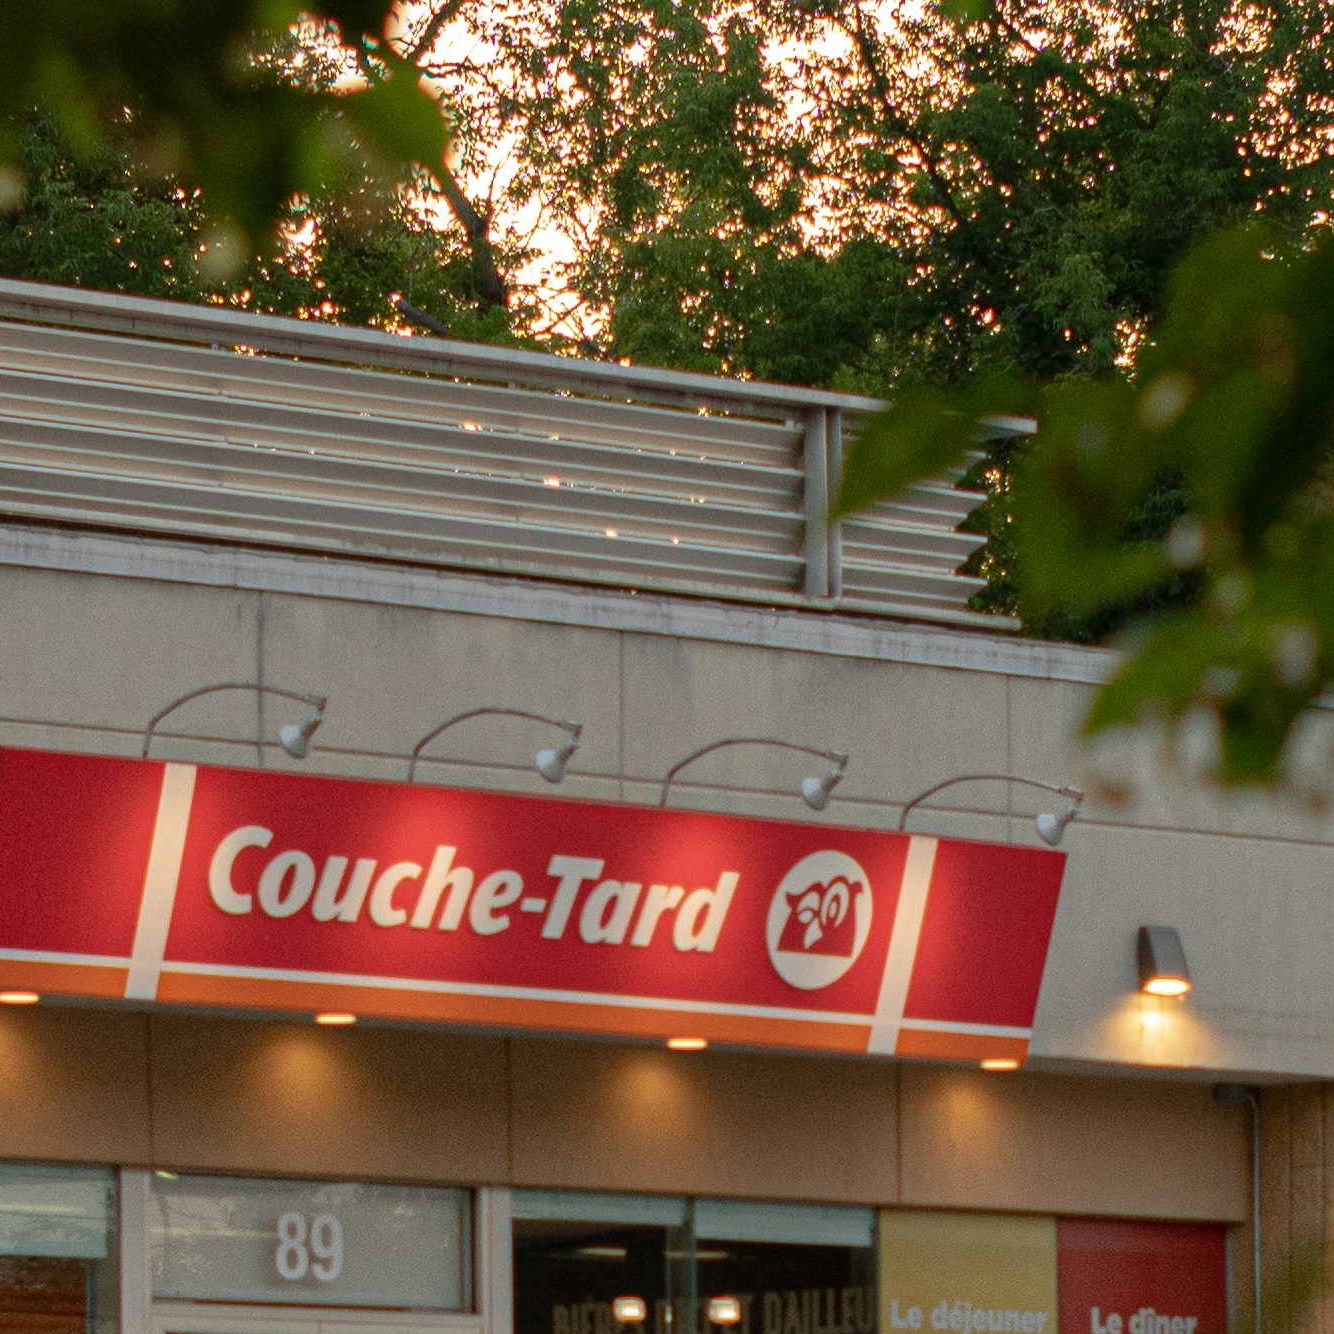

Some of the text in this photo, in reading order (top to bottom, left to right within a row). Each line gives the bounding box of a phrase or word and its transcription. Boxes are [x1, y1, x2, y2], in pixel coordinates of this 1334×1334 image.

[208, 824, 740, 953] Couche-Tard
[275, 1211, 345, 1281] 89
[890, 1300, 923, 1329] Le
